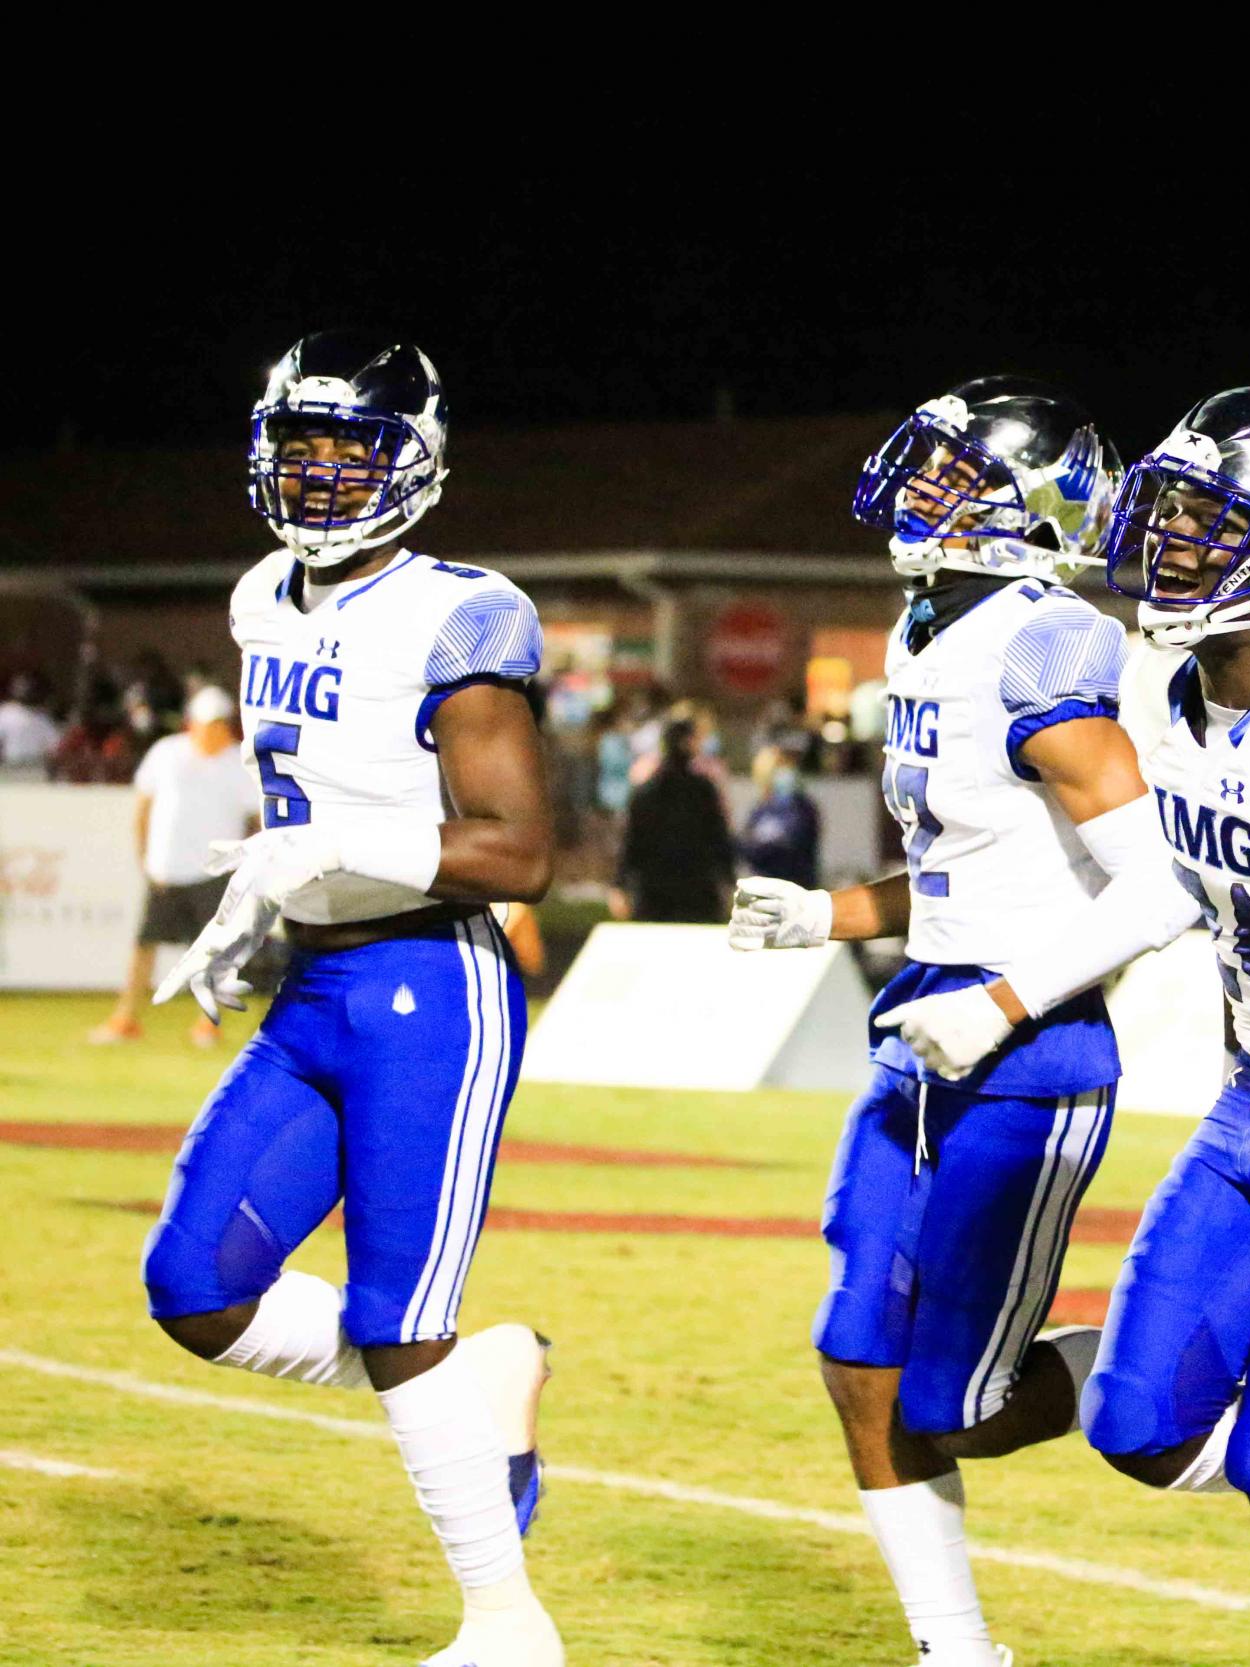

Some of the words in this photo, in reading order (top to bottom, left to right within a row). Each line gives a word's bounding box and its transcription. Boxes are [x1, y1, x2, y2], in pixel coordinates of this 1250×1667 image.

[244, 654, 343, 722] IMG
[886, 693, 940, 758] MG
[253, 718, 312, 830] 5
